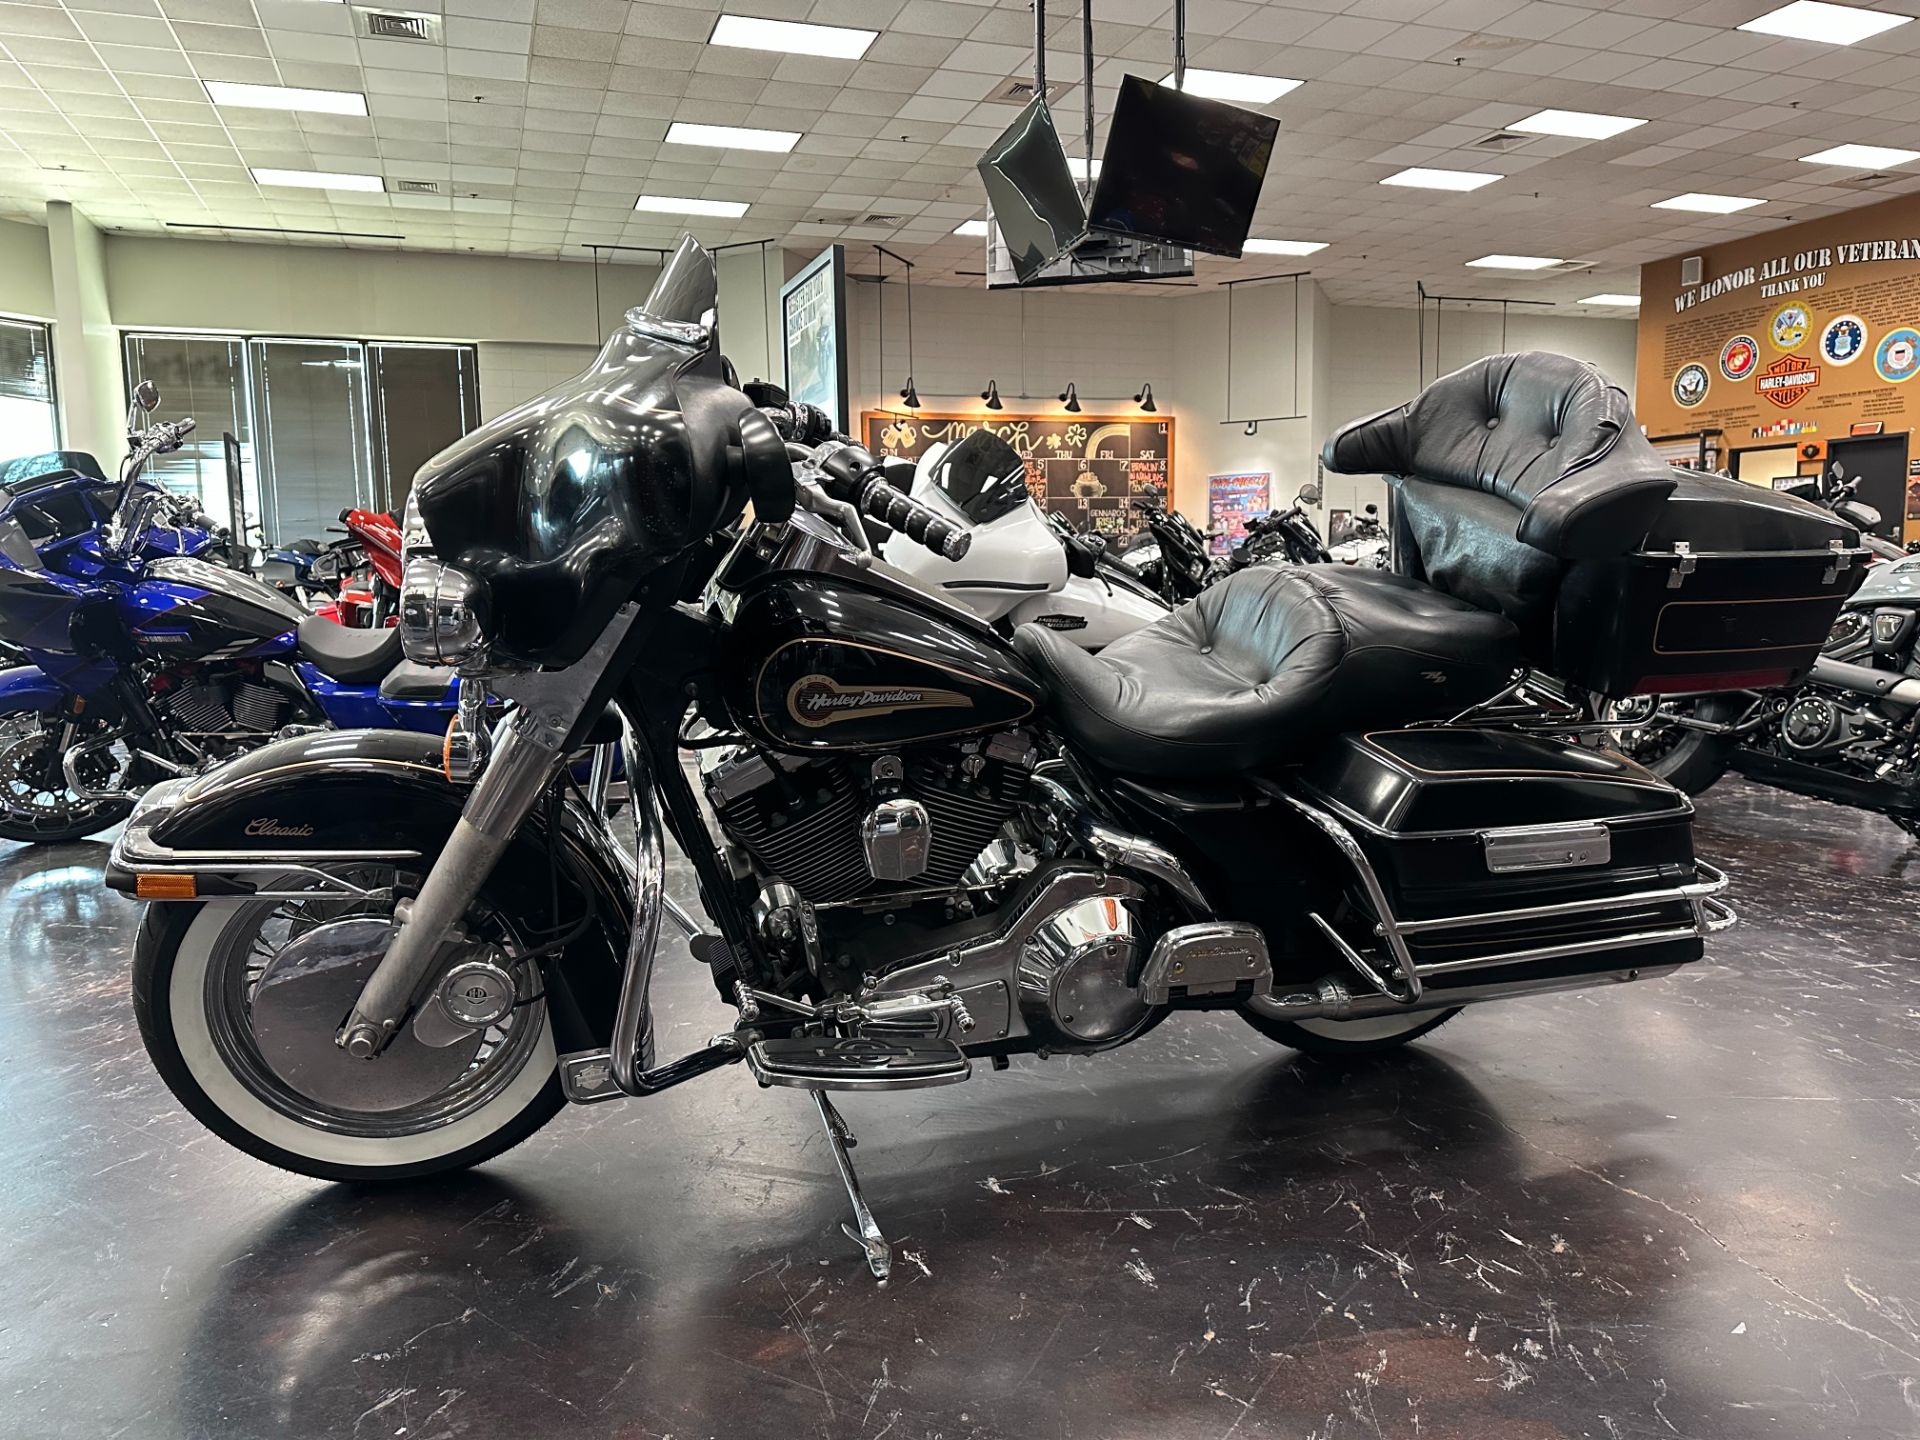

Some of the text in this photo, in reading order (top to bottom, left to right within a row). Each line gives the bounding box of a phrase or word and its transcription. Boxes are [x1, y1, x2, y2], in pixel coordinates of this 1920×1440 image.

[1674, 289, 1697, 313] WE
[1699, 267, 1755, 303] HONOR
[1759, 256, 1790, 281] ALL
[1793, 248, 1831, 272] OUR
[1761, 272, 1826, 299] THANK YOU
[1773, 359, 1803, 373] MOTOR
[1760, 372, 1816, 390] HARLEY-DAVIDSON
[1773, 388, 1802, 403] CYCLES
[880, 448, 898, 457] SUN
[1055, 450, 1073, 459] THU
[1100, 450, 1114, 460] FRI
[1140, 450, 1156, 460] SAT
[1037, 460, 1044, 470] 5
[1080, 460, 1087, 470] 6
[1121, 460, 1128, 470] 7
[1160, 460, 1167, 470] 8
[1078, 498, 1088, 509] 13
[1119, 498, 1129, 509] 14
[1159, 498, 1168, 508] 15
[1119, 536, 1129, 546] 21
[244, 817, 314, 837] Classic
